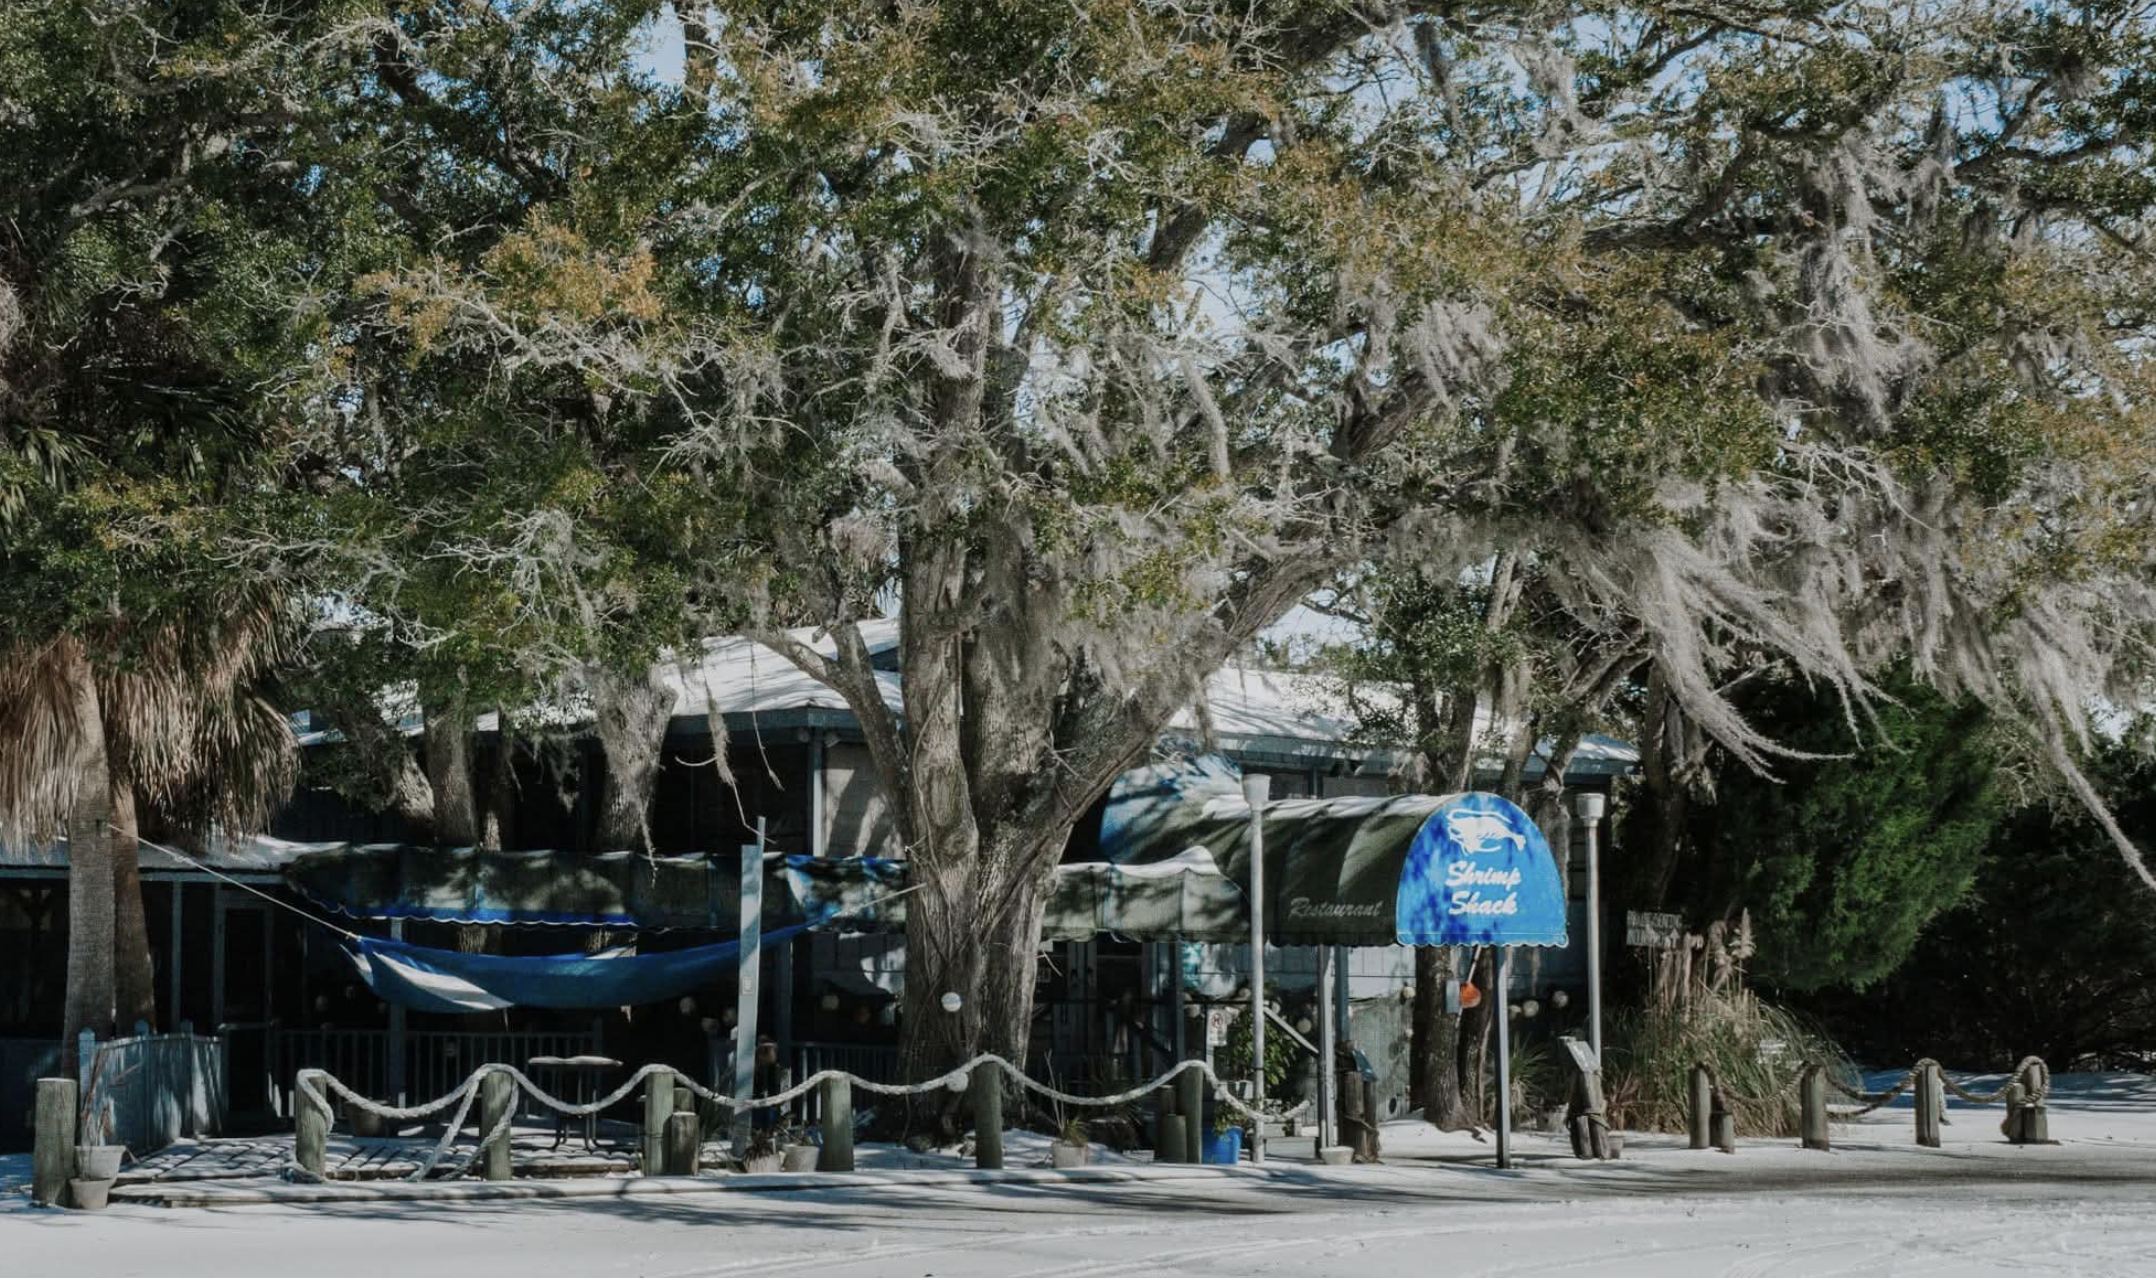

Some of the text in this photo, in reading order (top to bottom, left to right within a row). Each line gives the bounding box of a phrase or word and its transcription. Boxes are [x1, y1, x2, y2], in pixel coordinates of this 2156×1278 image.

[1445, 860, 1522, 891] Shrimp
[1288, 897, 1383, 920] Restaurant
[1448, 890, 1518, 915] Shack
